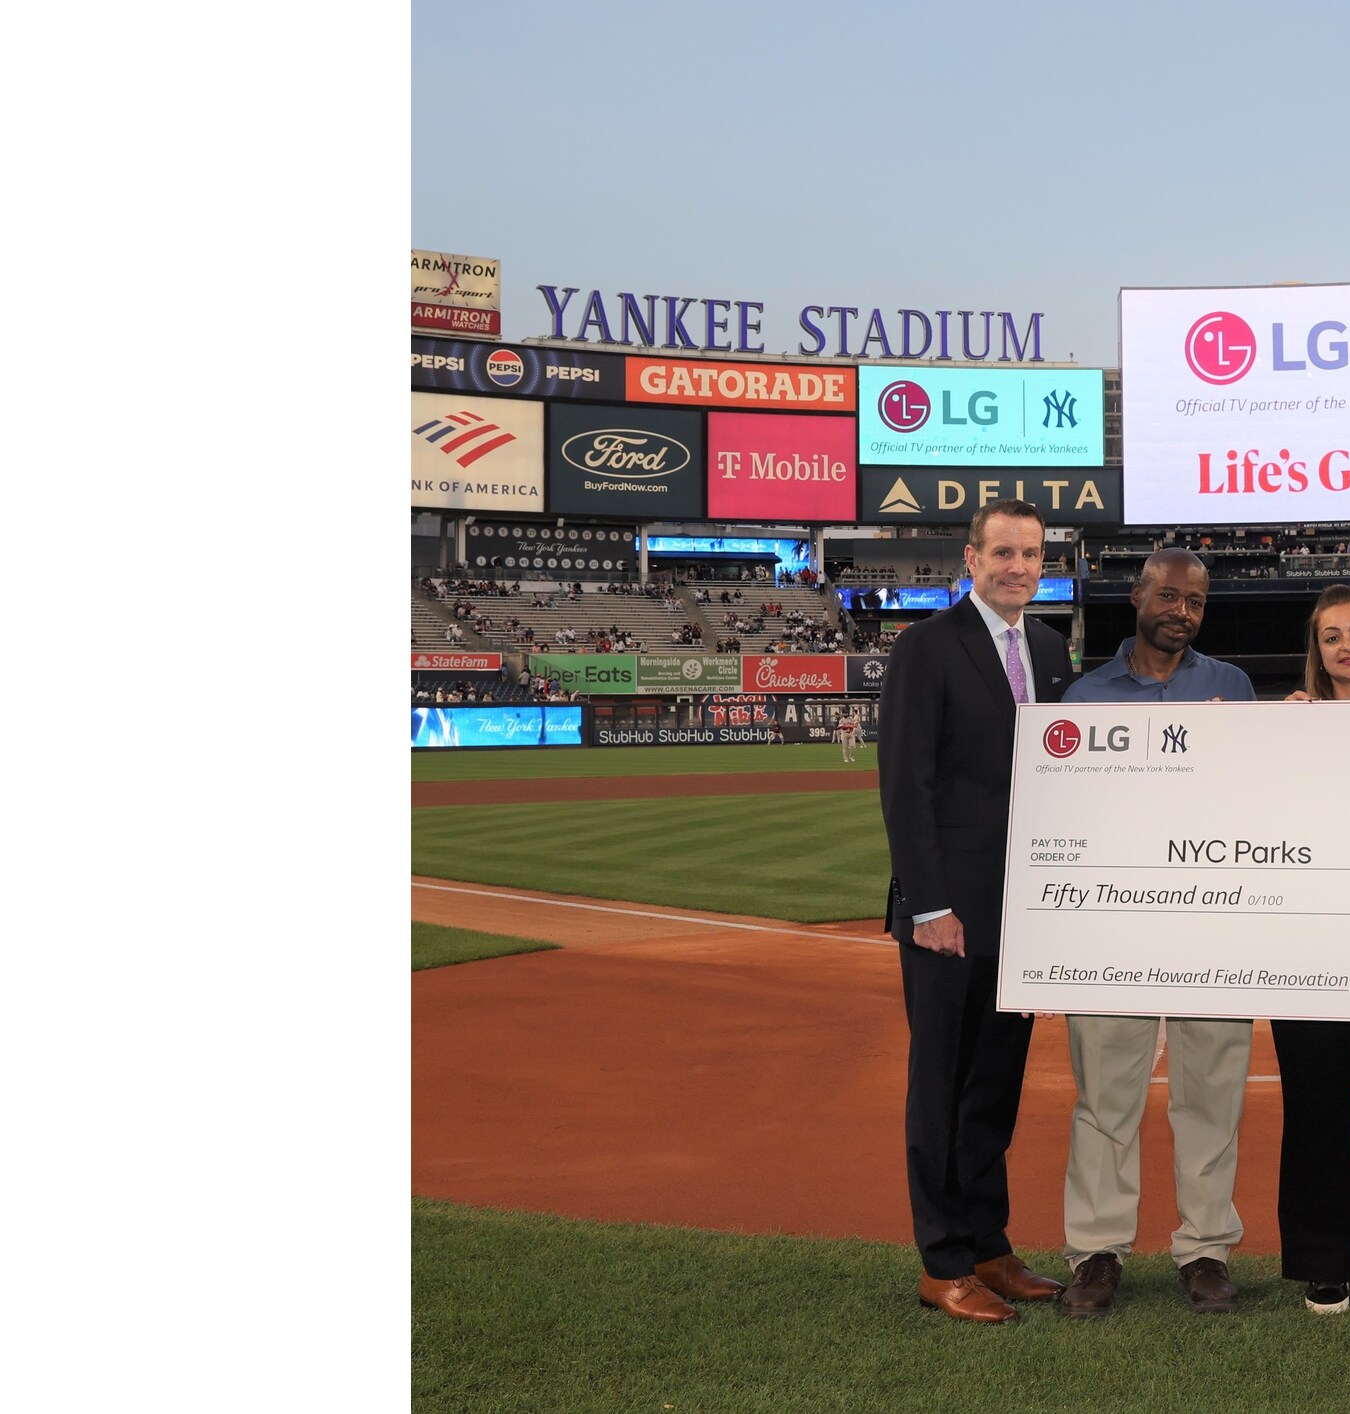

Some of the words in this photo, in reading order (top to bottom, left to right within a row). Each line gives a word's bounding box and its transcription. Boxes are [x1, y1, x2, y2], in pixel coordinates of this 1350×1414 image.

[411, 258, 496, 277] ARMITRON
[413, 306, 491, 323] ARMITRON
[537, 284, 764, 352] YANKEE
[799, 305, 1044, 362] STADIUM
[452, 321, 489, 330] WATCHES
[1272, 320, 1349, 372] LG
[411, 354, 464, 371] PEPSI
[489, 362, 521, 373] PEPSI
[546, 366, 600, 382] PEPSI
[640, 365, 845, 402] GATORADE
[942, 390, 998, 425] LG
[1176, 398, 1225, 416] Official
[1230, 399, 1247, 412] TV
[1250, 399, 1302, 415] partner
[1306, 396, 1322, 413] of
[1324, 396, 1346, 409] the
[585, 434, 669, 471] Ford
[870, 441, 907, 454] Official
[911, 443, 924, 452] TV
[925, 444, 963, 454] partner
[967, 444, 979, 455] of
[980, 444, 996, 453] the
[999, 444, 1022, 453] New
[1024, 444, 1046, 453] York
[1049, 444, 1088, 454] Yankees
[750, 453, 846, 481] Mobile
[1198, 449, 1308, 494] Life's
[439, 481, 459, 492] OF
[464, 482, 538, 496] AMERICA
[585, 480, 668, 493] BuyFordNow.com
[517, 541, 536, 551] New
[536, 542, 554, 555] York
[556, 544, 587, 556] Yankees
[641, 657, 680, 668] Morningside
[702, 657, 737, 666] Workmen's
[718, 666, 737, 674] Circle
[585, 666, 632, 683] Eats
[756, 662, 832, 689] Chick-fil-A
[477, 718, 504, 732] New
[505, 719, 534, 738] York
[600, 730, 653, 743] StubHub
[659, 730, 714, 743] StubHub
[720, 729, 774, 742] StubHub
[1088, 725, 1130, 751] LG
[1036, 765, 1062, 774] Official
[1074, 766, 1102, 774] partner
[1105, 765, 1113, 774] of
[1032, 839, 1050, 848] PAY
[1053, 839, 1066, 848] TO
[1069, 839, 1087, 848] THE
[1168, 839, 1226, 863] NYC
[1235, 840, 1312, 864] Parks
[1030, 853, 1064, 862] ORDER
[1067, 853, 1081, 861] OF
[1042, 883, 1089, 908] Fifty
[1097, 884, 1197, 904] Thousand
[1202, 886, 1242, 905] and
[1248, 896, 1283, 906] 0/100
[1022, 970, 1043, 980] FOR
[1049, 965, 1097, 982] Elston
[1102, 967, 1142, 982] Gene
[1147, 968, 1209, 984] Howard
[1214, 969, 1253, 985] Field
[1257, 970, 1349, 988] Renovation
